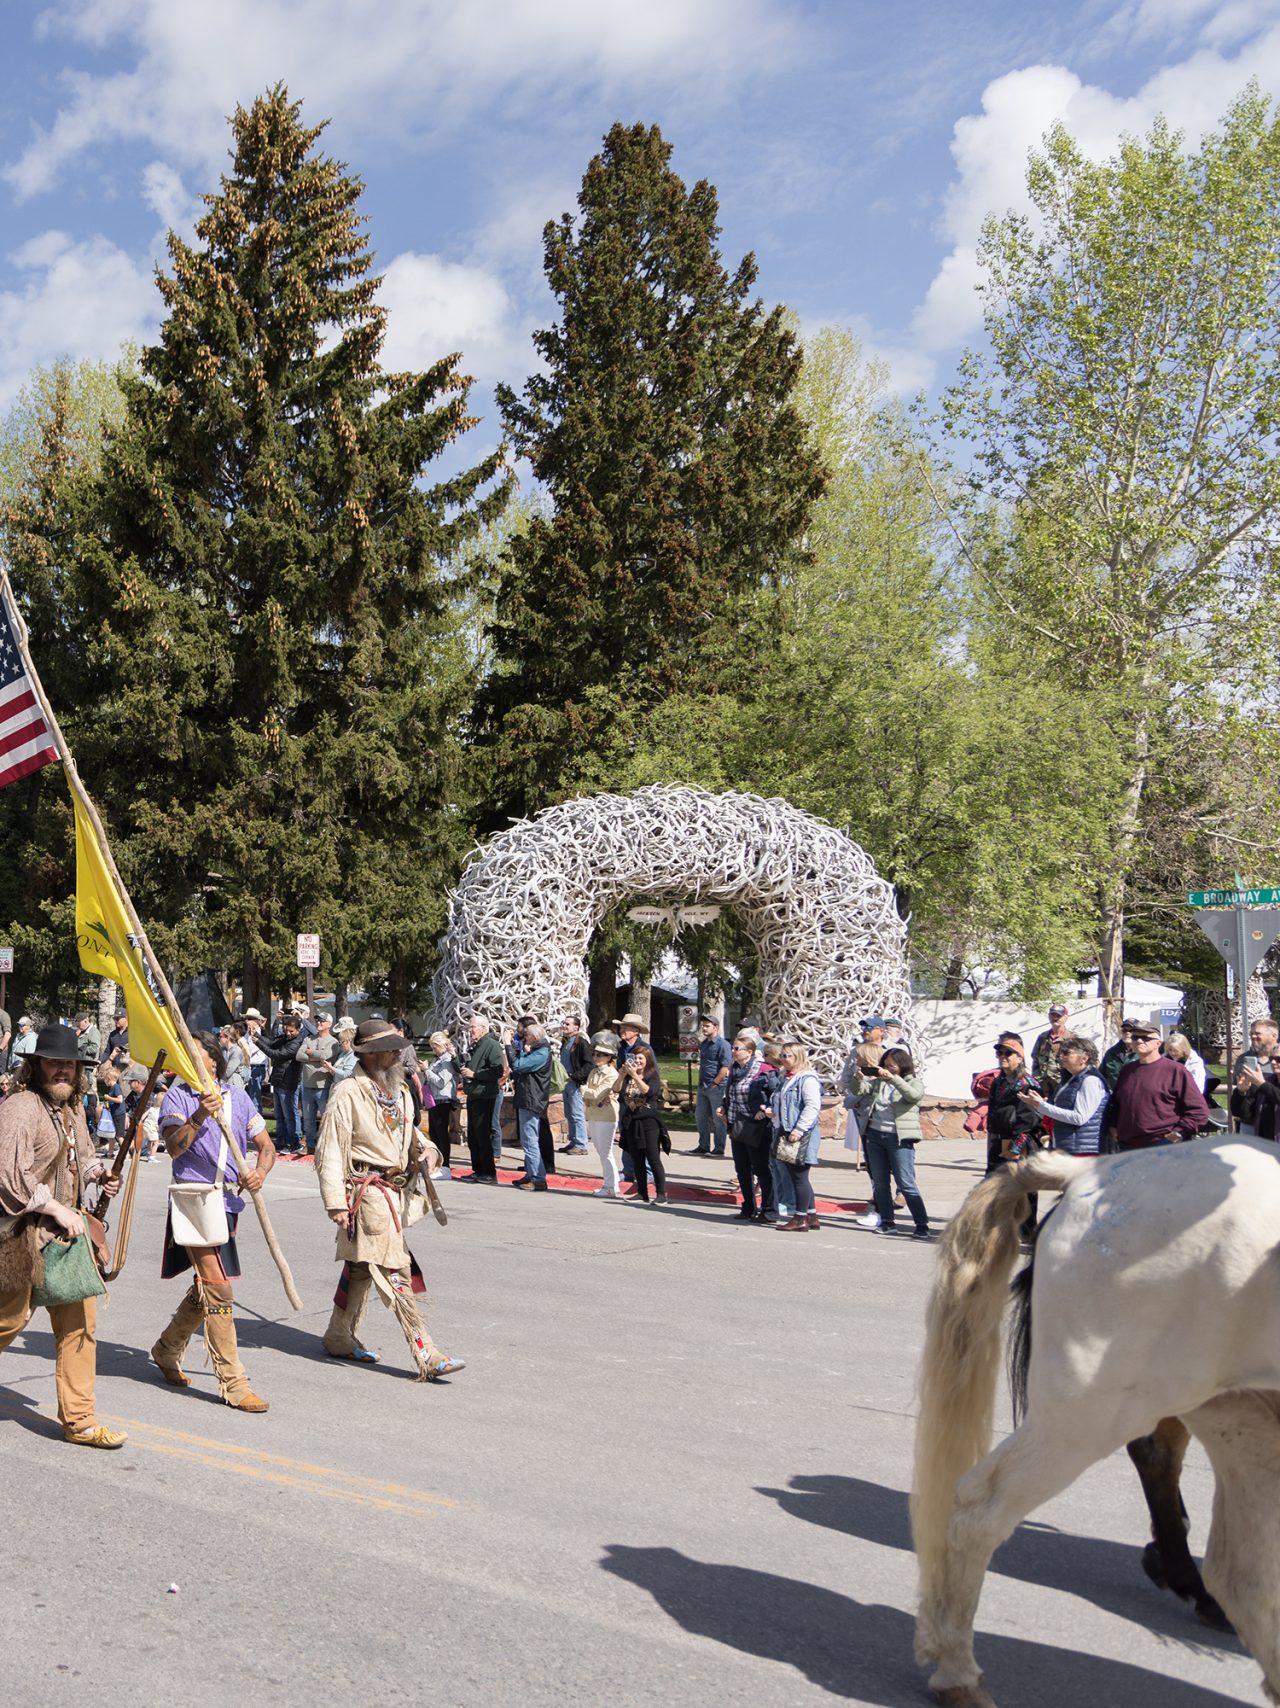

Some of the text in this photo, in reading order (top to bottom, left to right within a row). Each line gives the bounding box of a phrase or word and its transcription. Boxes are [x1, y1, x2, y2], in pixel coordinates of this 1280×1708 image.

[1188, 893, 1195, 904] E
[1203, 890, 1261, 904] BROADWAY
[77, 934, 114, 958] ONT
